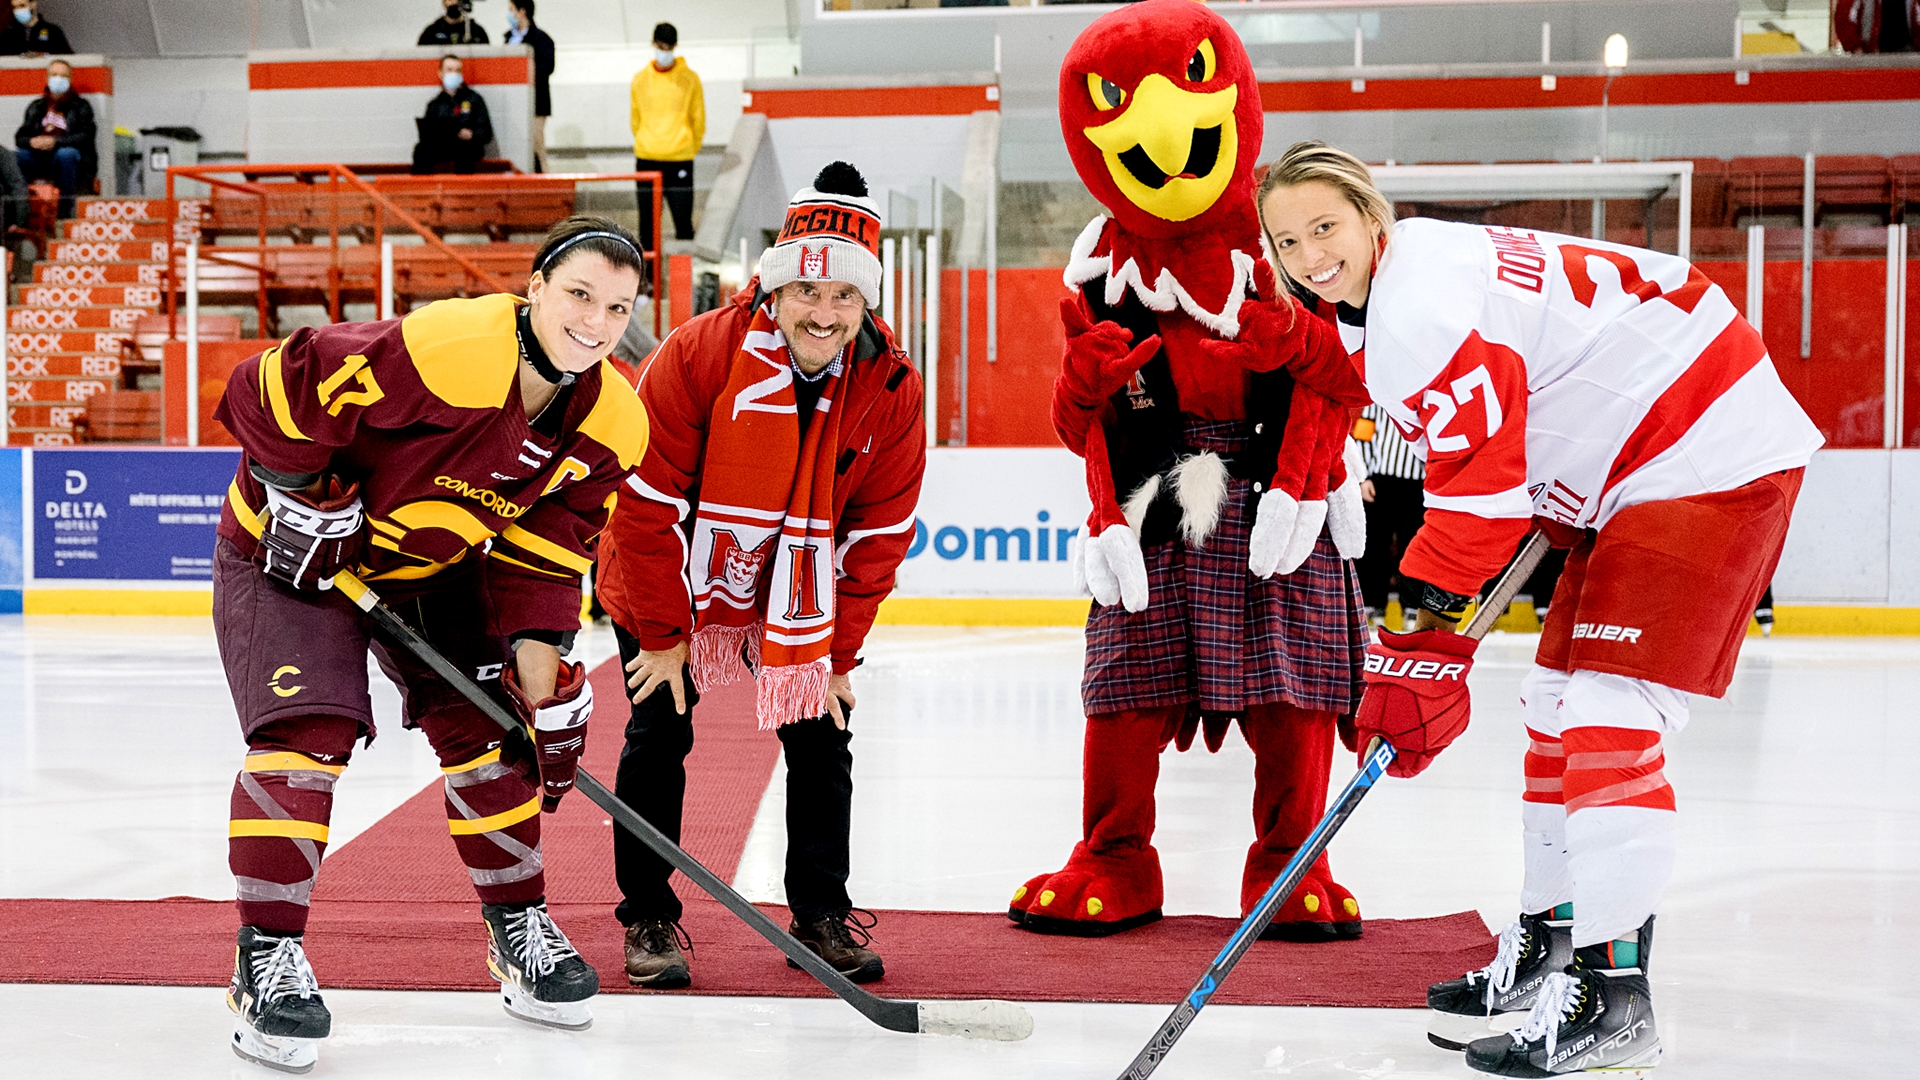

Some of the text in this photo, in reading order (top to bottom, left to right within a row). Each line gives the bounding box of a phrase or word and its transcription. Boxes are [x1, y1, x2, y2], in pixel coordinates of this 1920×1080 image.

[124, 287, 161, 306] RED
[81, 356, 120, 376] RED
[317, 354, 385, 417] 17
[1422, 363, 1502, 453] 27
[46, 501, 108, 518] DELTA
